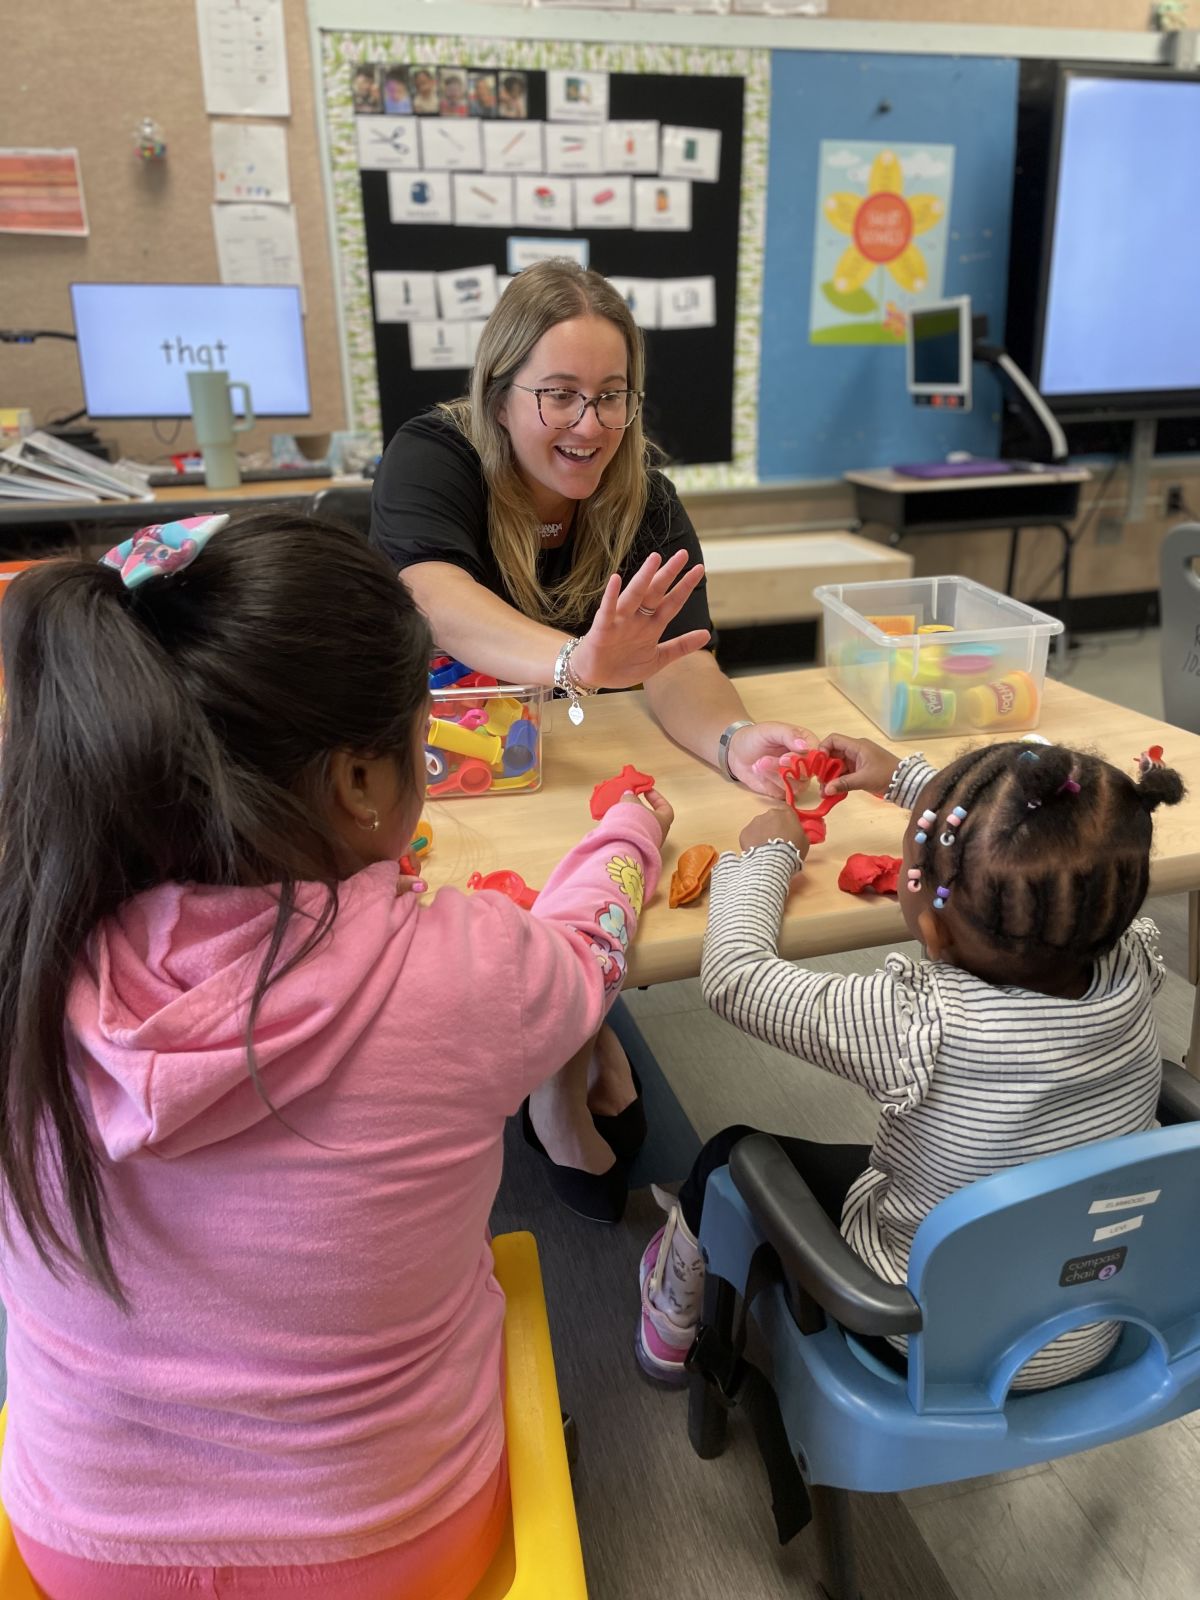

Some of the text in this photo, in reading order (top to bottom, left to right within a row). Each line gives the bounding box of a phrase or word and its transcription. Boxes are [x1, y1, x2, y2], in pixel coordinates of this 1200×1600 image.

[1069, 1252, 1121, 1270] compass
[1065, 1266, 1114, 1282] chair 2
